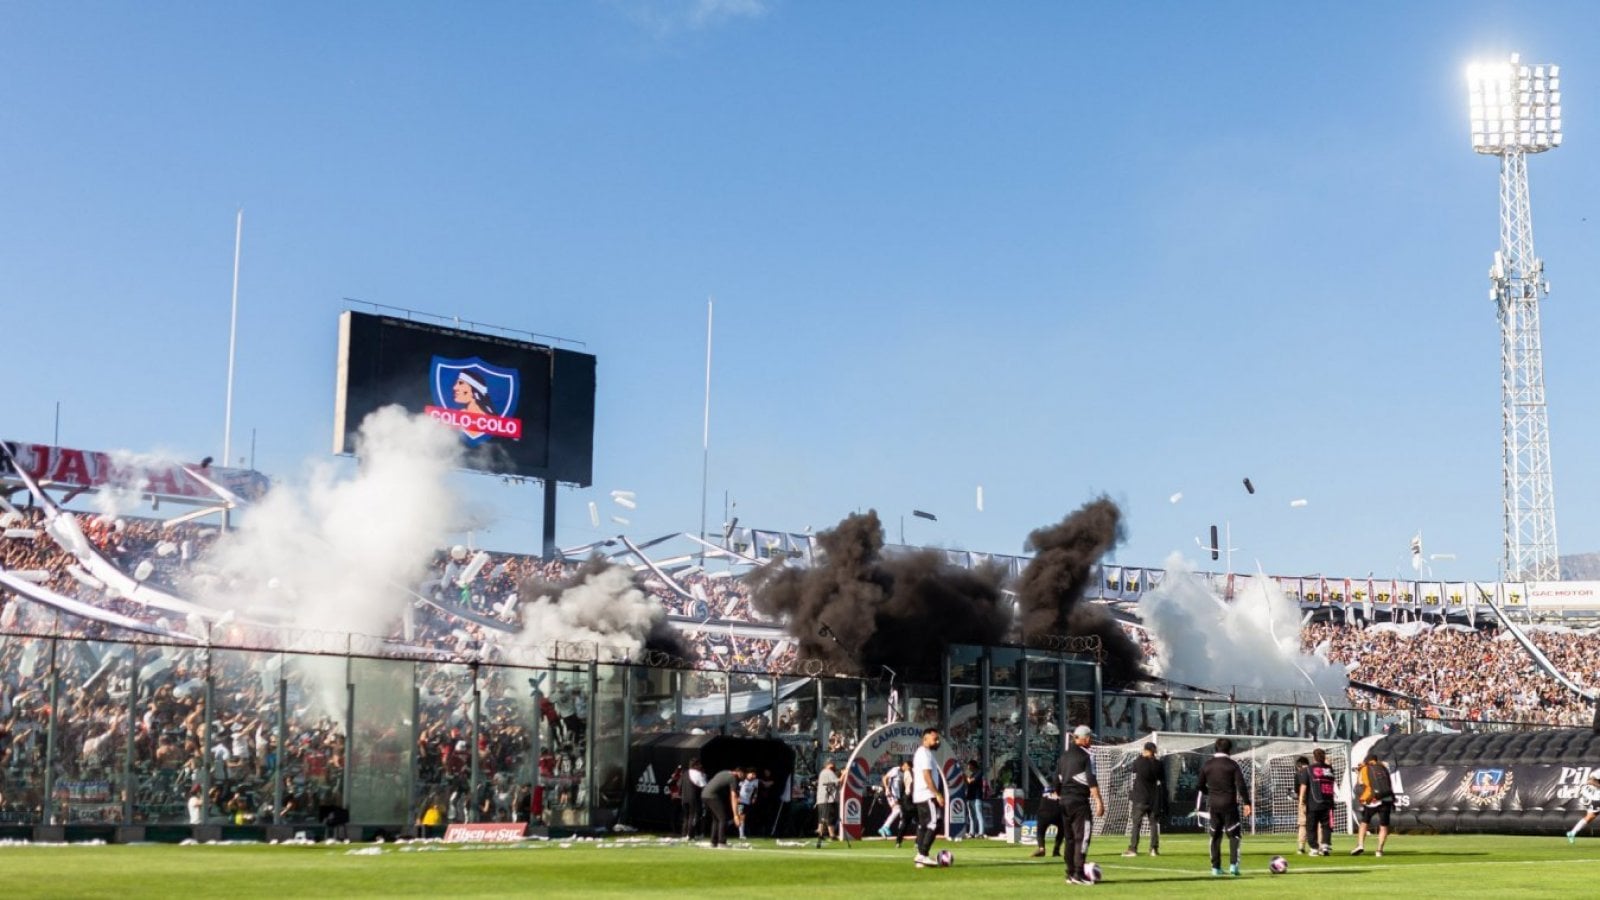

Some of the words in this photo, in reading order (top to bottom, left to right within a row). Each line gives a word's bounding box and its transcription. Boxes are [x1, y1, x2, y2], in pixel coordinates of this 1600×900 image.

[430, 410, 517, 434] COLO-COLO
[871, 726, 923, 749] CAMPEON
[1557, 766, 1592, 785] Pil
